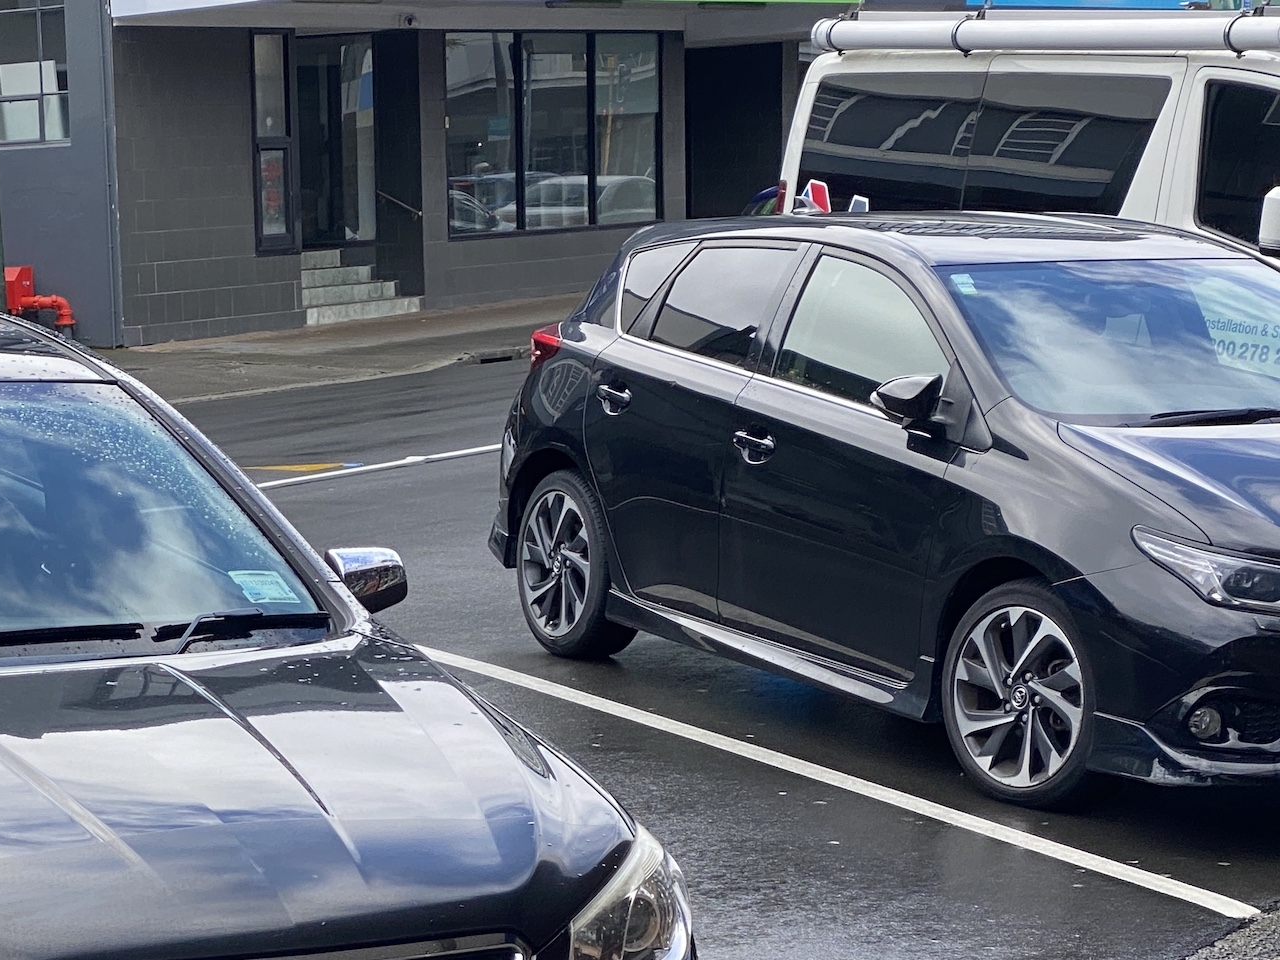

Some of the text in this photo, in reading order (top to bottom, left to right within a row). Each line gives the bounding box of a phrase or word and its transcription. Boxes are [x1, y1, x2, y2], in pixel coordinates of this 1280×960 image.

[1204, 316, 1259, 336] nstallation
[1260, 323, 1269, 338] &
[1237, 342, 1271, 363] 278
